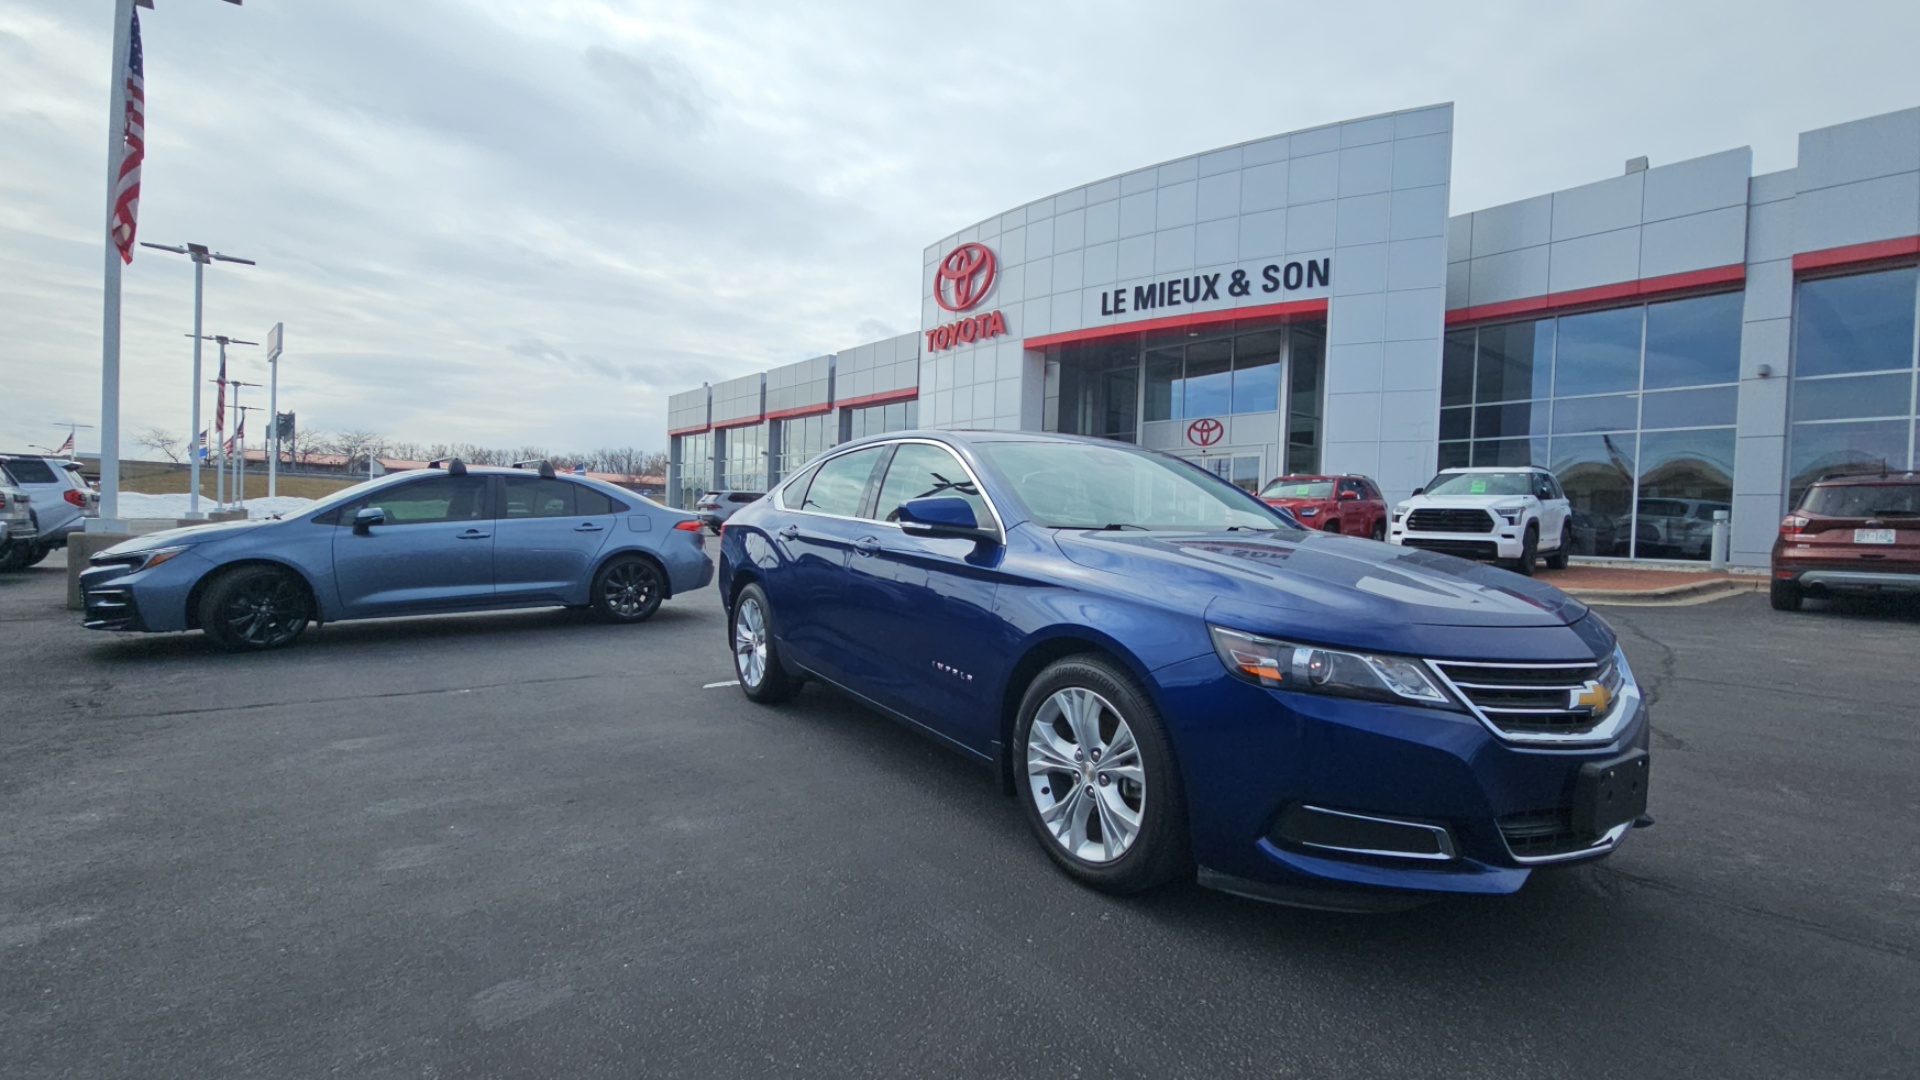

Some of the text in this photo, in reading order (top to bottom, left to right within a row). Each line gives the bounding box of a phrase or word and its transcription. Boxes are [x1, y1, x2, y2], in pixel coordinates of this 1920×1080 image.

[1101, 257, 1330, 316] LE MIEUX & SON
[925, 310, 1006, 352] TOYOTA
